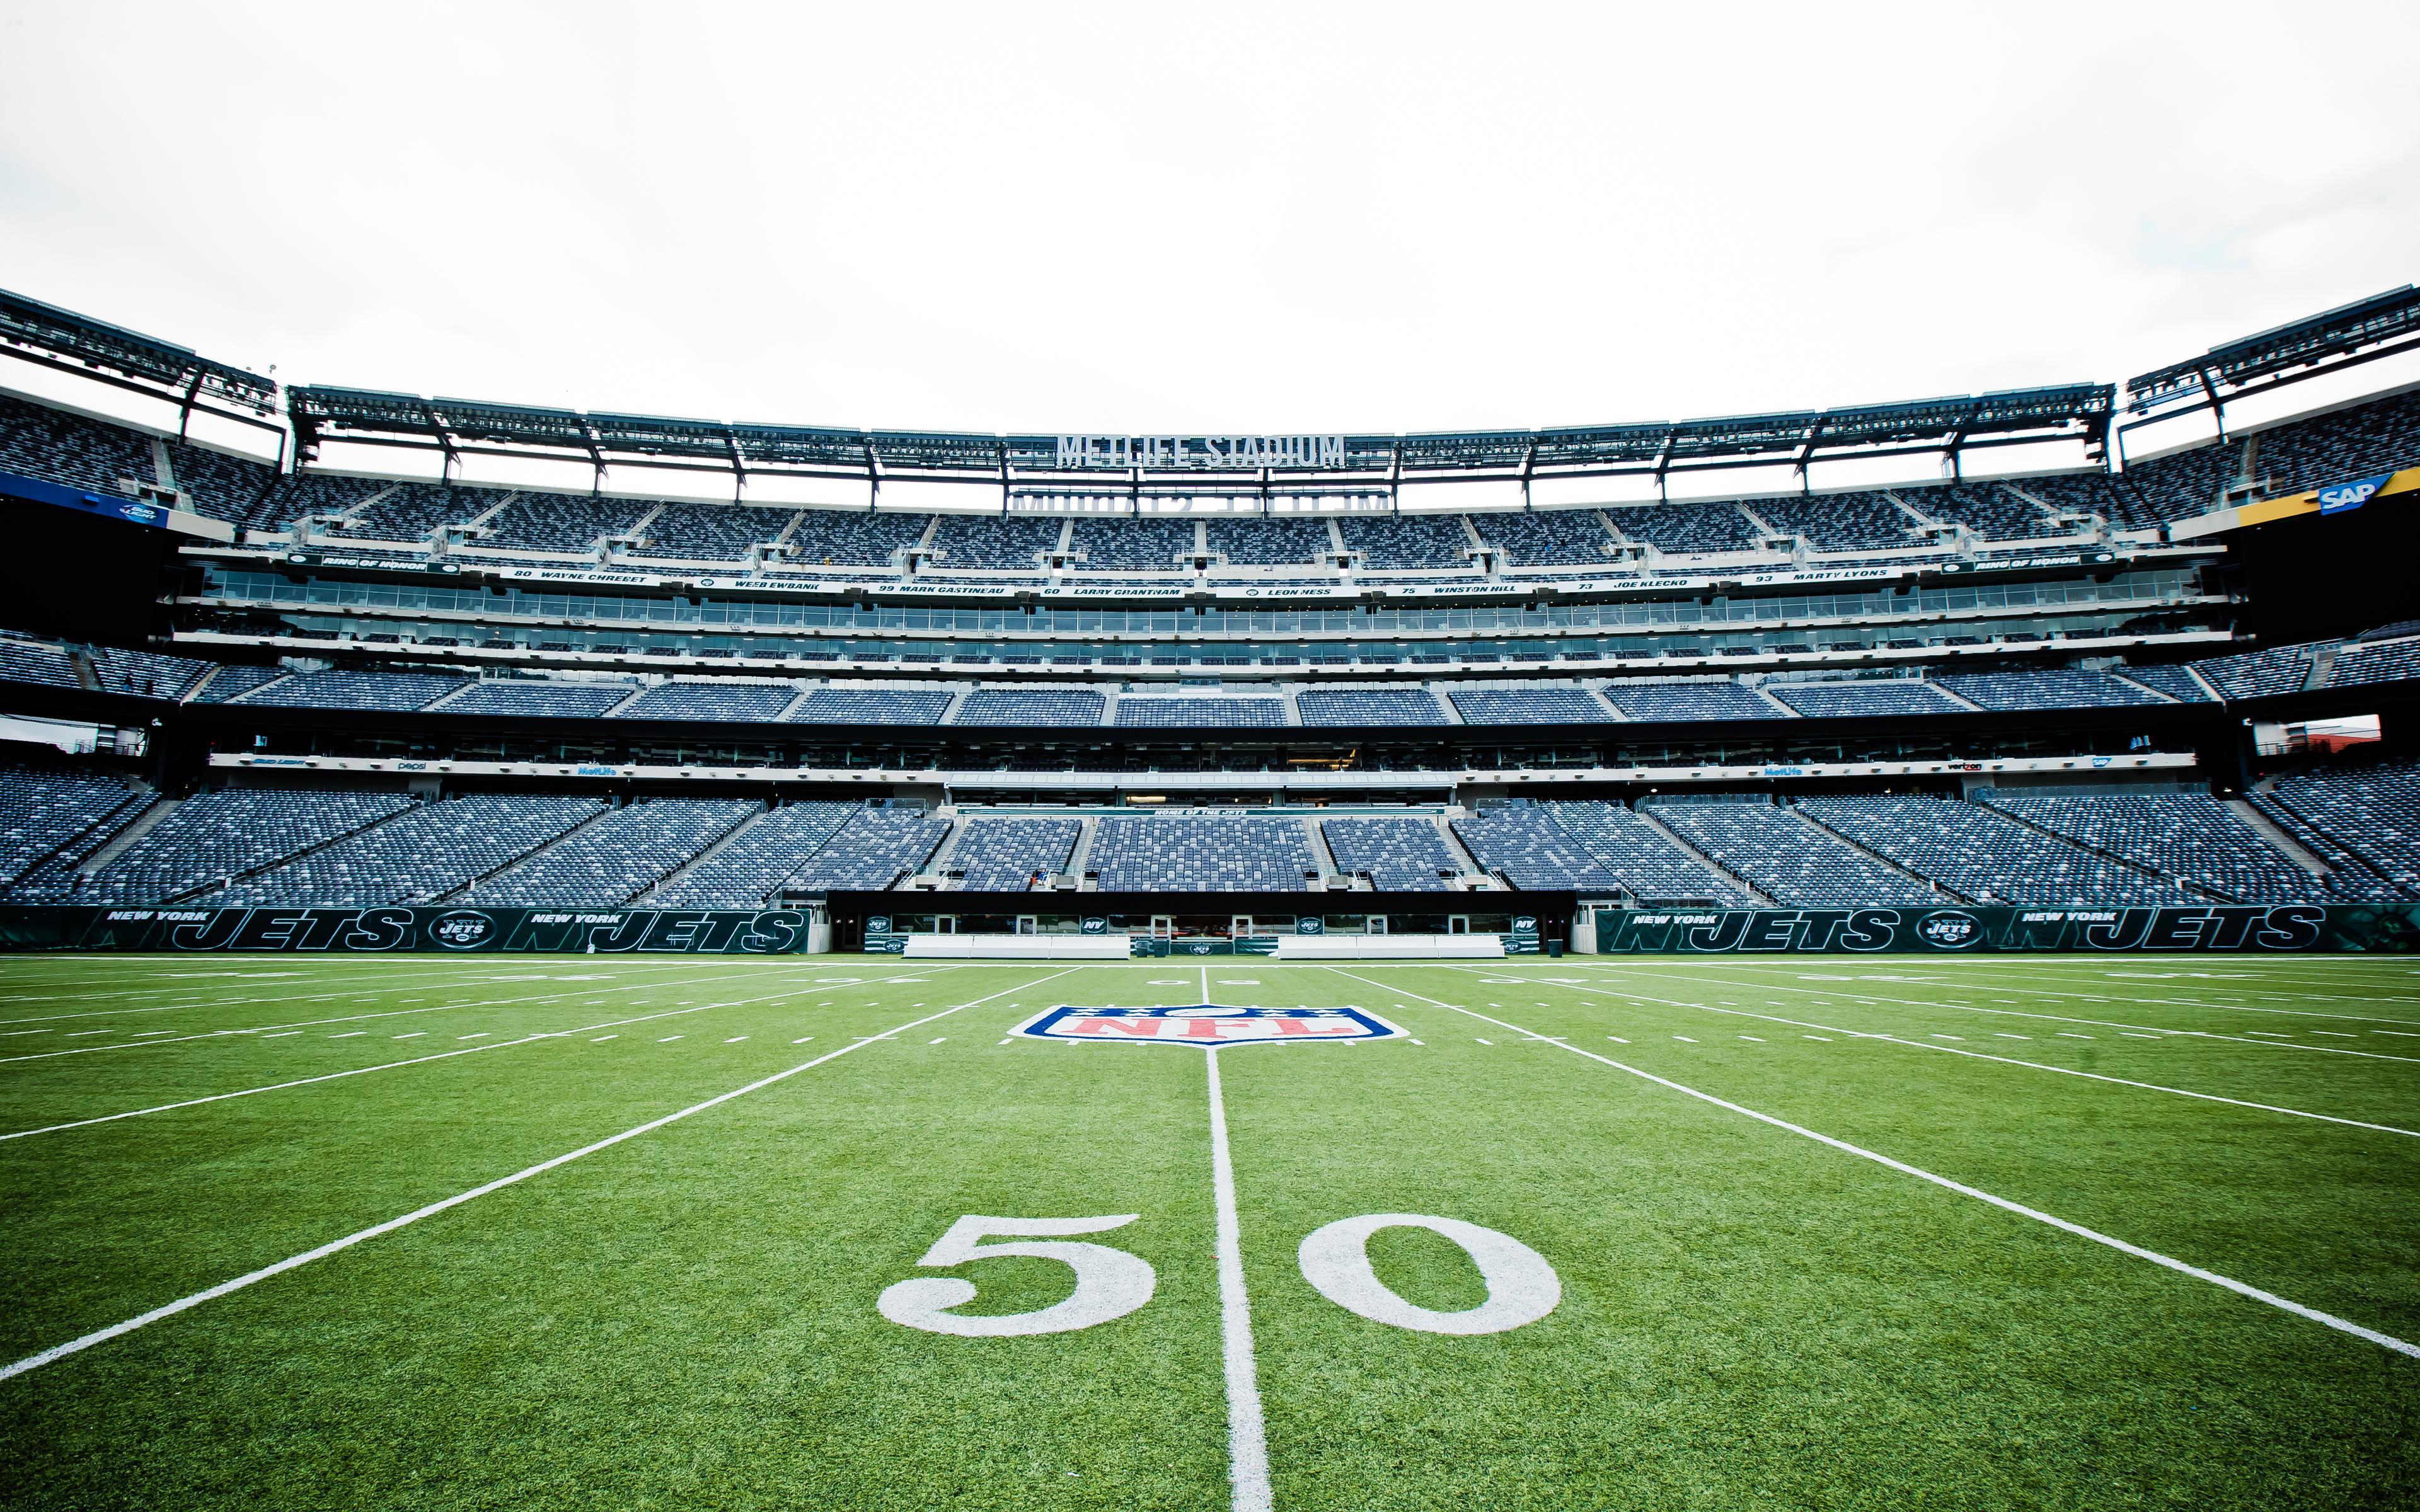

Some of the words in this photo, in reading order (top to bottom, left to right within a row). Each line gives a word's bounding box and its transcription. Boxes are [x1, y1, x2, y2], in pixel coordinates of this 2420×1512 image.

[1057, 435, 1192, 467] METLIFE
[1204, 435, 1345, 467] STADIUM
[2322, 484, 2376, 509] SAP
[323, 557, 358, 566] RING
[378, 560, 427, 570] HONOR
[1975, 561, 2009, 570] RING
[2030, 556, 2080, 566] HONOR
[588, 575, 647, 583] CHREBET
[1793, 572, 1841, 580] MARTY
[398, 762, 427, 770] pepsi
[1947, 762, 1982, 770] verizon
[577, 767, 616, 776] MetLife
[1764, 767, 1802, 776] MetLife
[107, 911, 157, 920] NEW
[156, 911, 210, 921] YORK
[531, 914, 572, 923] NEW
[574, 914, 623, 924] YORK
[1632, 915, 1671, 924] NEW
[1673, 914, 1718, 924] YORK
[2021, 912, 2063, 922] NEW
[2066, 912, 2118, 922] YORK
[172, 907, 413, 950] JETS
[440, 924, 485, 934] JETS
[1083, 921, 1105, 929] NY
[1515, 920, 1536, 928] NY
[1927, 924, 1971, 934] JETS
[2087, 905, 2326, 949] JETS
[589, 910, 804, 951] JETS
[1690, 909, 1901, 951] JETS
[1059, 1017, 1357, 1039] NFL
